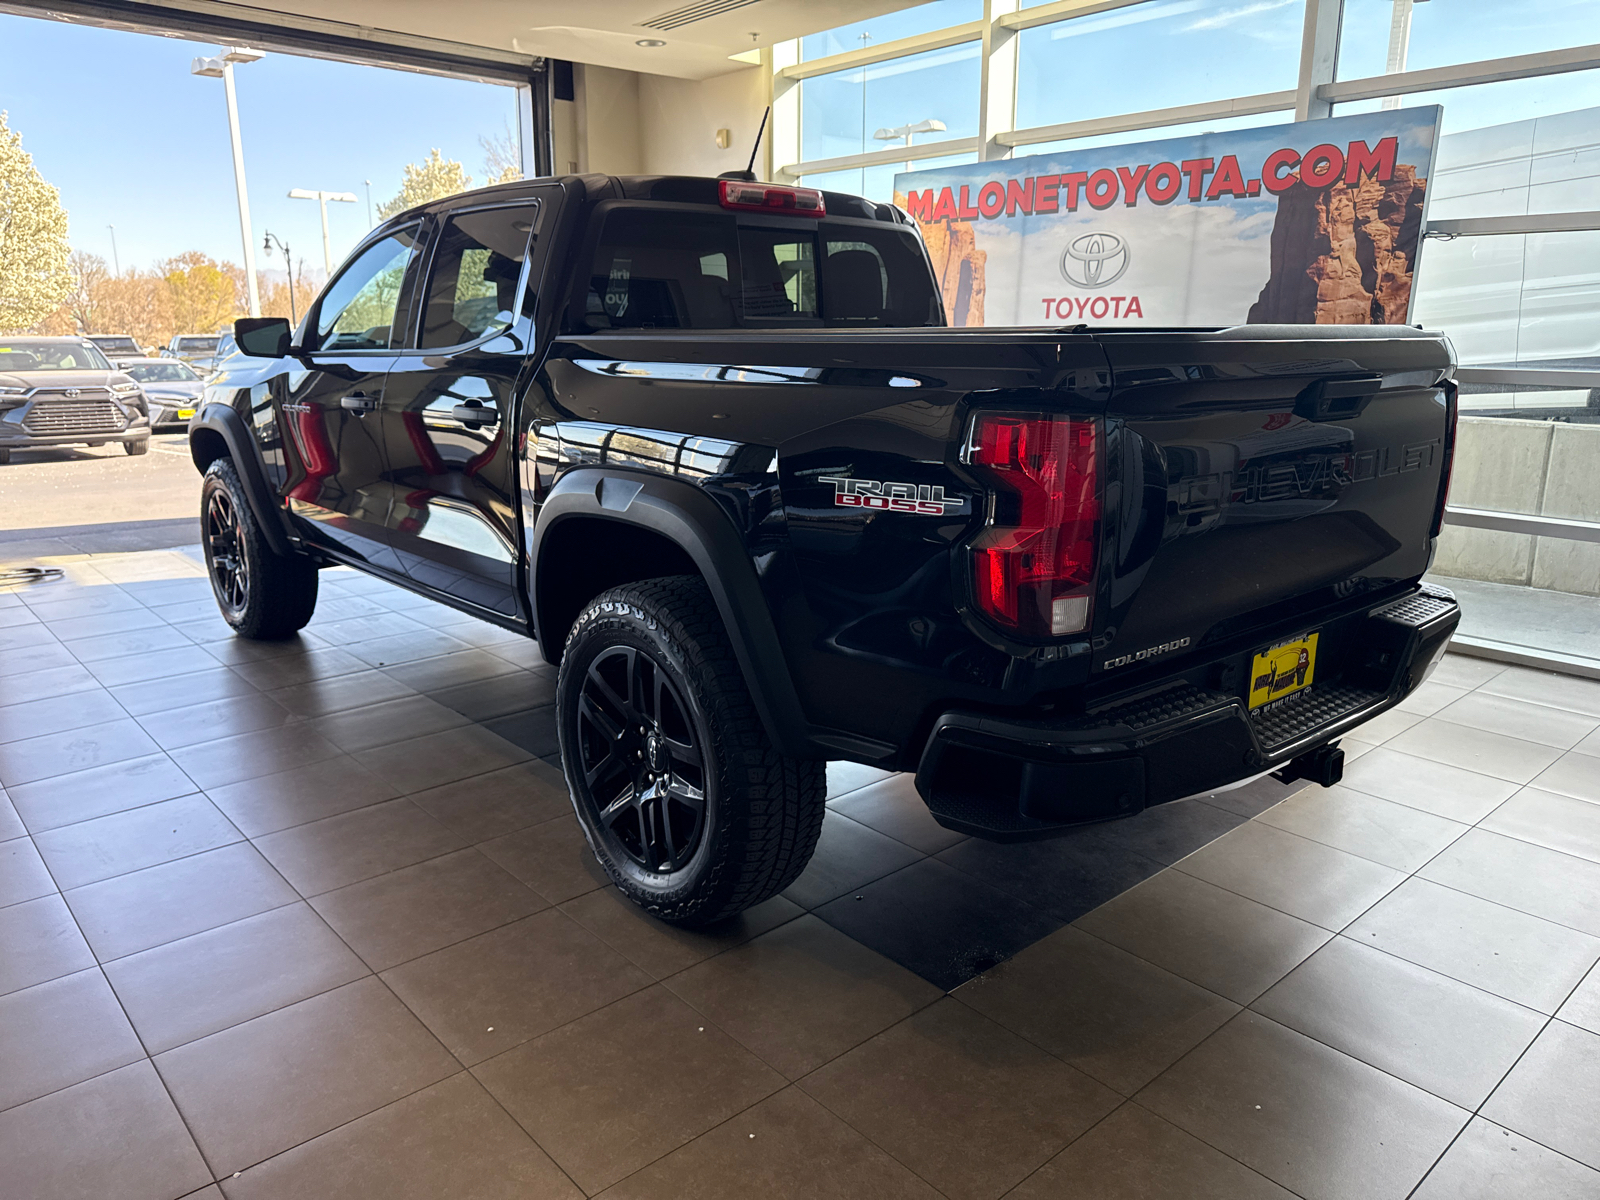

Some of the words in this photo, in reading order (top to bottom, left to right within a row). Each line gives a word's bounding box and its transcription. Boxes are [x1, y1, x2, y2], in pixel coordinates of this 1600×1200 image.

[907, 137, 1398, 222] MALONETOYOTA.COM
[1041, 296, 1143, 319] TOYOTA
[818, 476, 963, 505] TRAIL
[1177, 438, 1441, 516] CHEVROLET
[835, 493, 944, 515] BOSS
[1103, 636, 1191, 670] COLORADO
